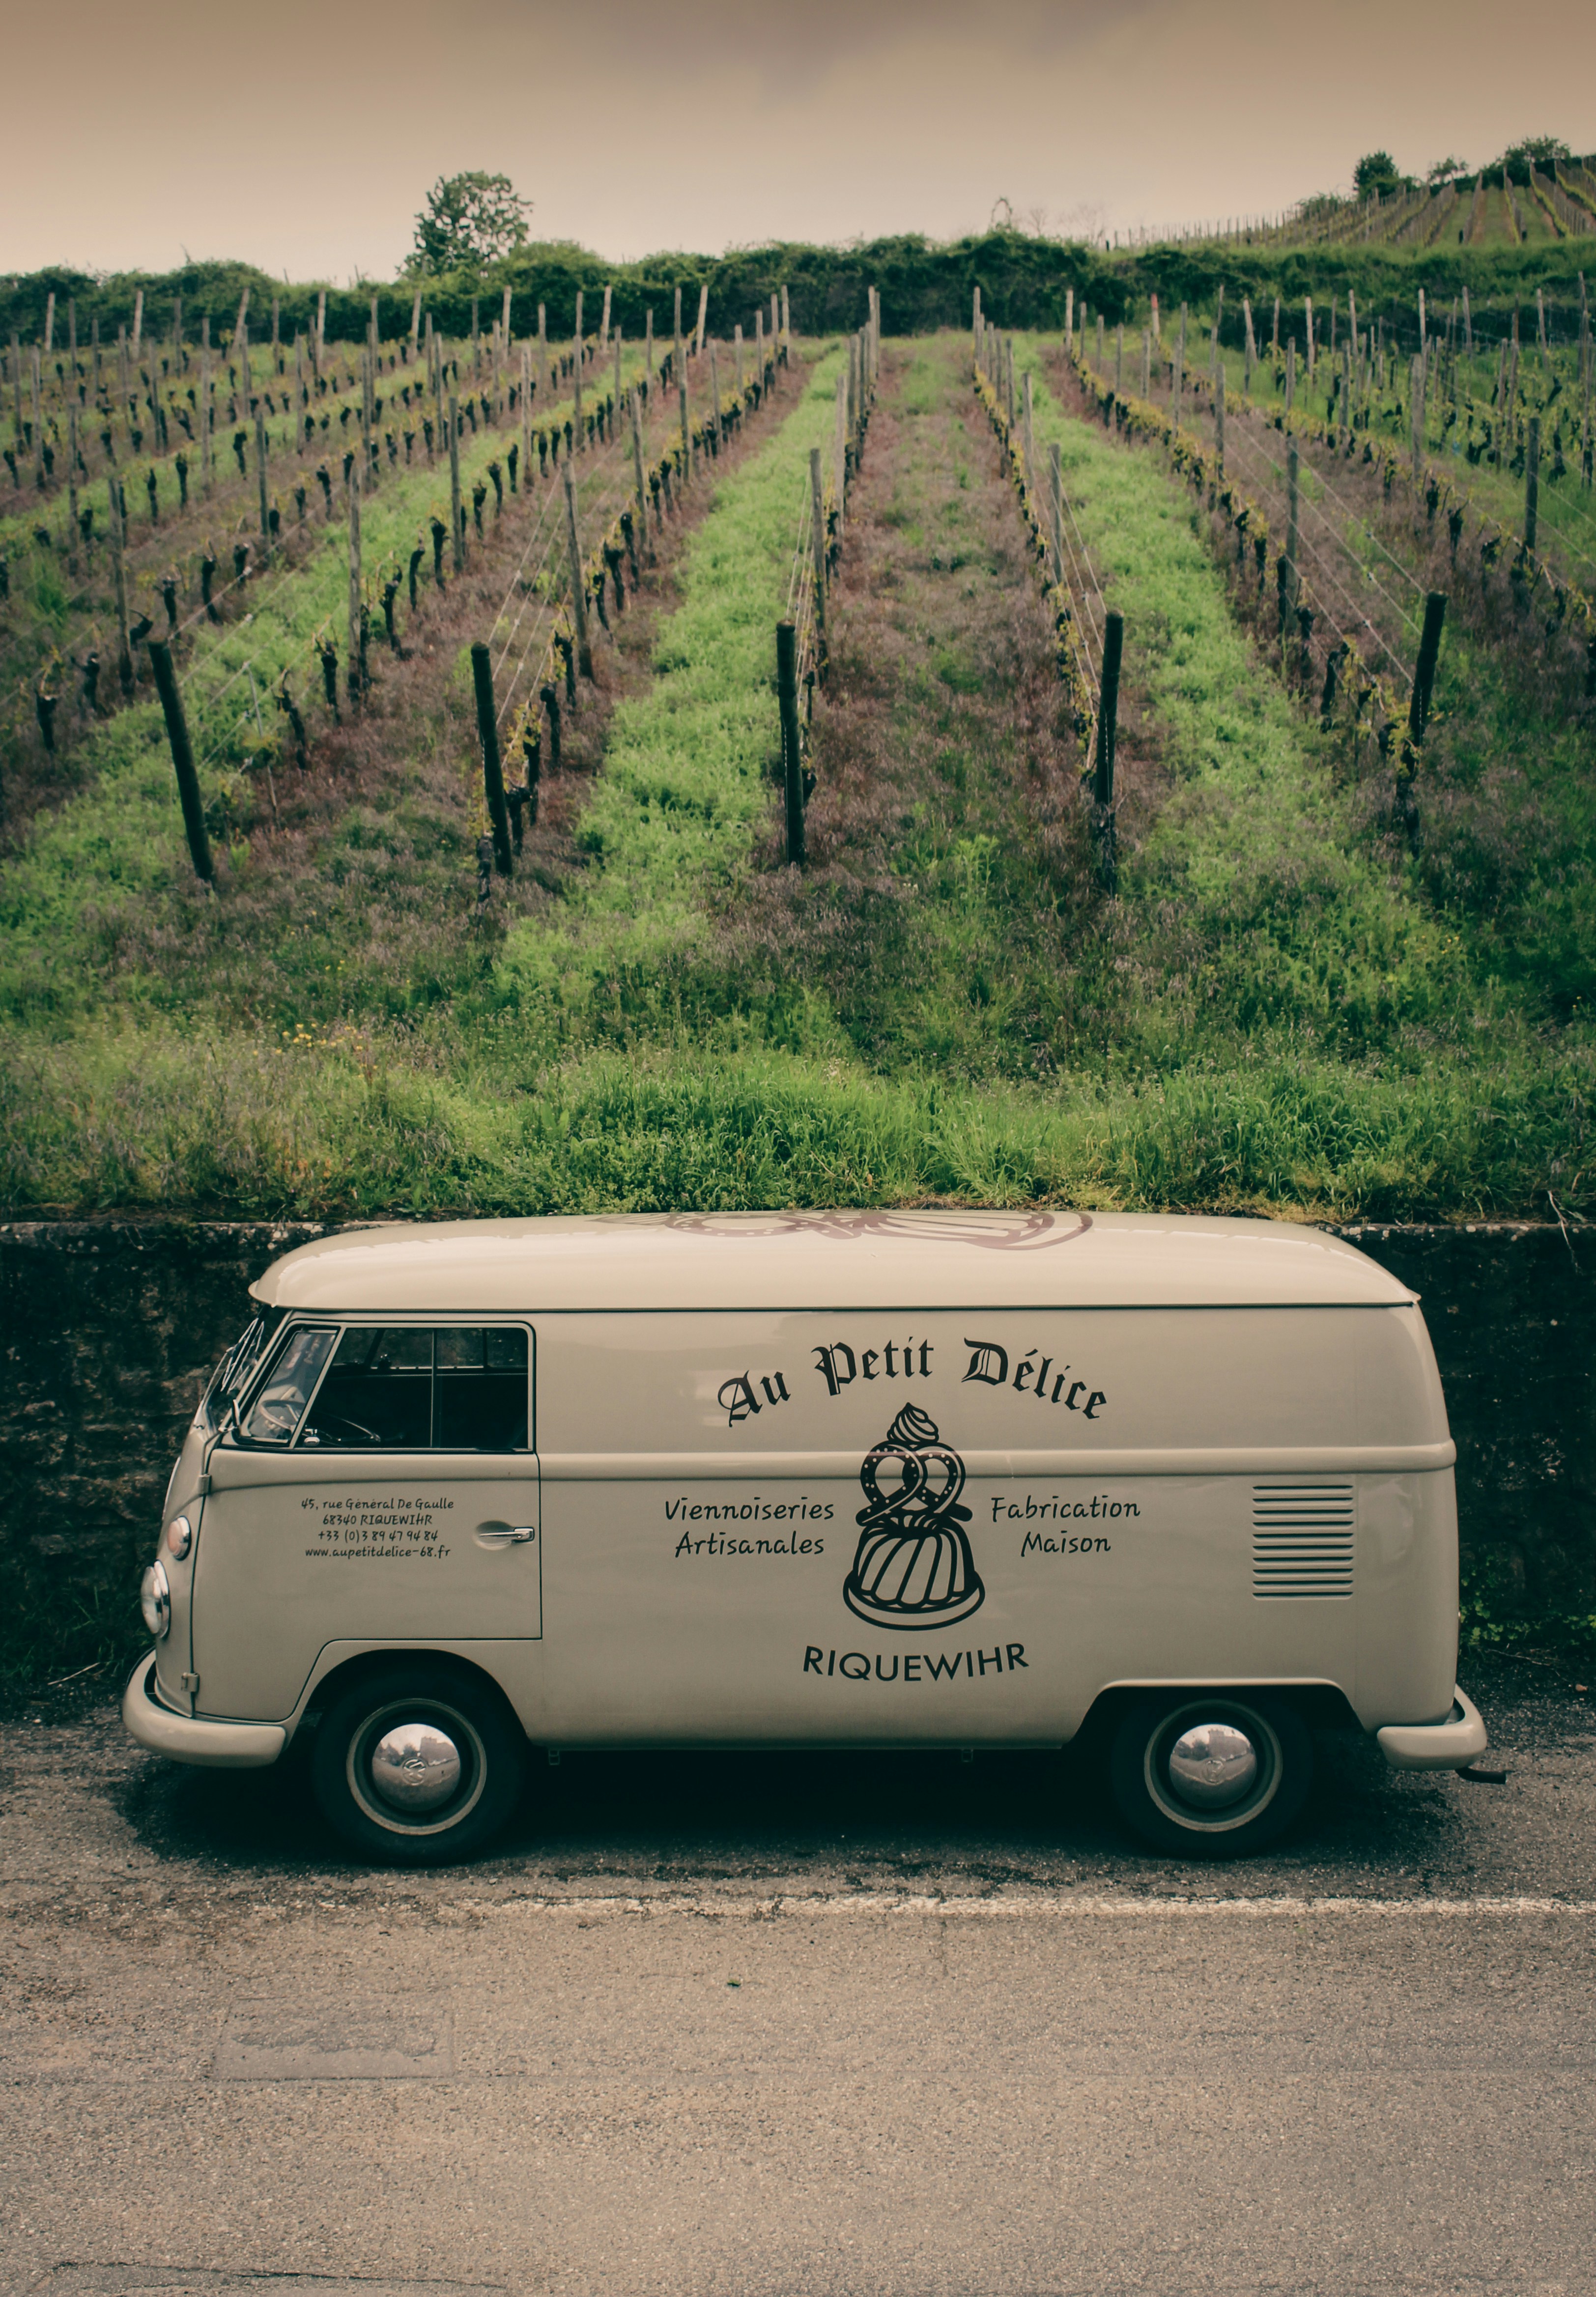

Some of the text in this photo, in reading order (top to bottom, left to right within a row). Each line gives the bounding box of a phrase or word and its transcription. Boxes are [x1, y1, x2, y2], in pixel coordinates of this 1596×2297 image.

[717, 1336, 1107, 1428] Au Petit Délice
[301, 1498, 318, 1510] 45,
[345, 1498, 395, 1510] Général
[398, 1499, 412, 1509] De
[415, 1497, 454, 1510] Gaulle
[665, 1497, 834, 1521] Viennoiseries
[991, 1495, 1140, 1523] Fabrication
[322, 1512, 432, 1526] 68340 RIQUEWIHR
[318, 1530, 339, 1541] +33
[371, 1531, 386, 1541] 89
[389, 1530, 403, 1542] 47
[406, 1530, 421, 1542] 94
[424, 1530, 438, 1542] 84
[675, 1530, 824, 1558] Artisanales
[1021, 1530, 1111, 1558] Maison
[305, 1544, 451, 1560] www.aupetitdelice-68.fr
[803, 1643, 1029, 1682] RIQUEWIHR
